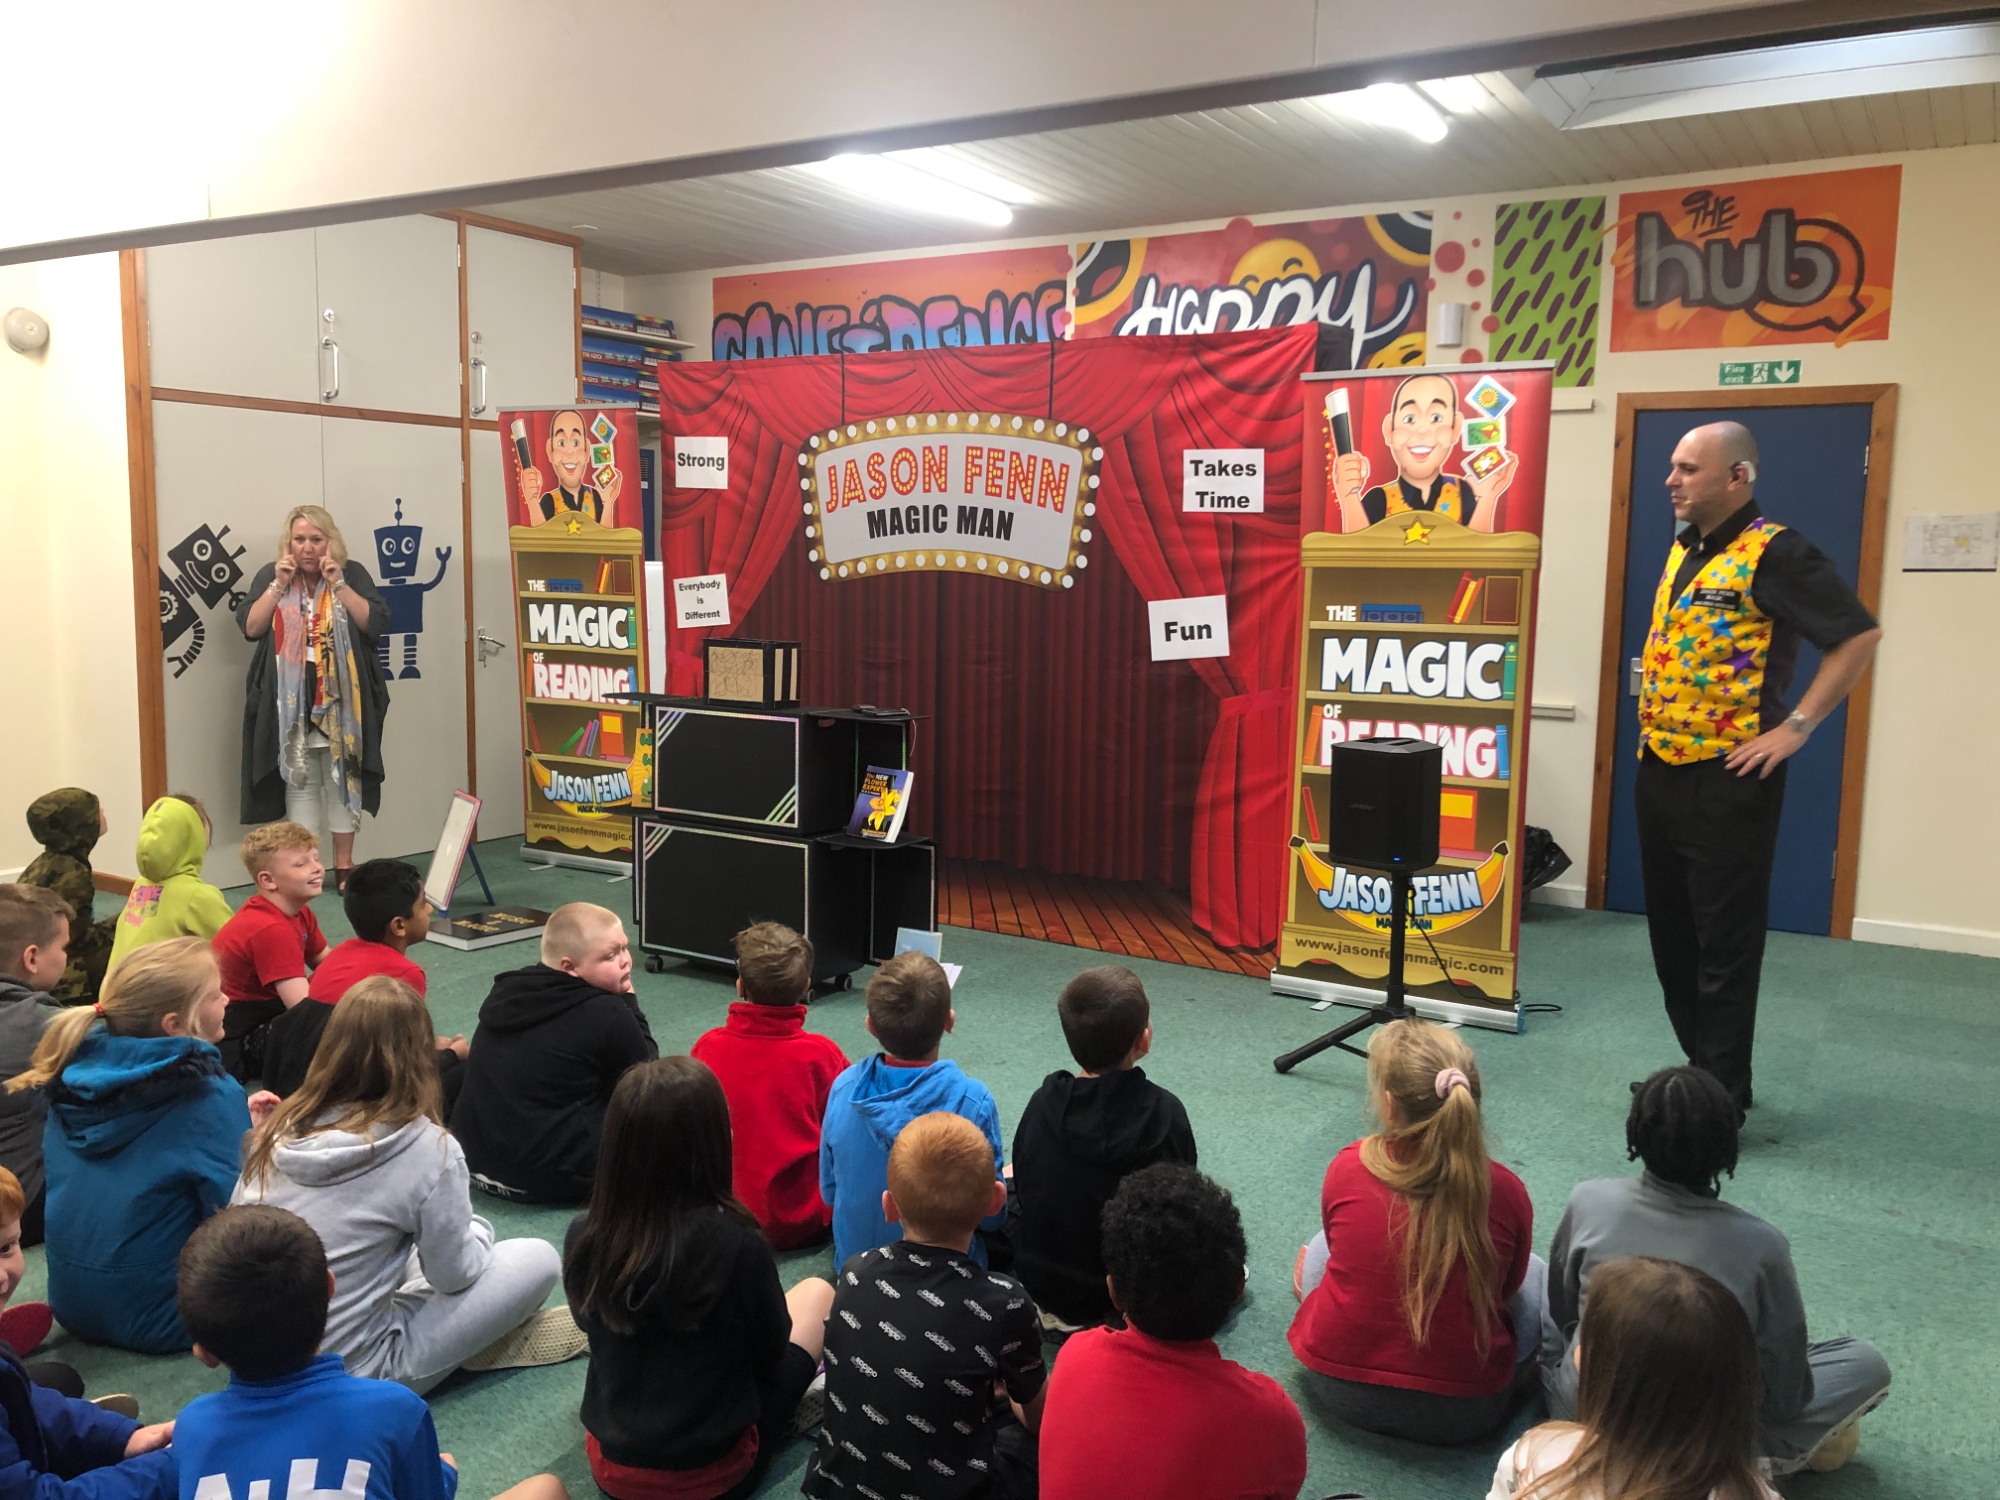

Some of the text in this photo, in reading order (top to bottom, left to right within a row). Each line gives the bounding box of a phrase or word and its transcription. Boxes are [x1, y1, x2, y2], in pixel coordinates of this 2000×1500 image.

[1681, 190, 1739, 231] THE
[1635, 209, 1839, 308] hub
[1725, 365, 1746, 373] Fire
[1725, 375, 1745, 383] exit
[677, 452, 725, 471] Strong
[1189, 459, 1257, 477] Takes
[825, 445, 1071, 514] JASON FENN
[1195, 491, 1250, 509] Time
[867, 504, 1015, 541] MAGIC MAN
[527, 579, 545, 592] THE
[678, 579, 721, 592] Everybody
[696, 597, 704, 605] is
[684, 610, 721, 620] Different
[1326, 605, 1357, 622] THE
[528, 603, 629, 650] MAGIC
[1164, 621, 1212, 642] Fun
[533, 652, 544, 663] OF
[1321, 637, 1505, 700] MAGIC
[533, 664, 630, 705] READING
[1323, 704, 1342, 718] OF
[543, 770, 633, 803] JASON FENN
[533, 821, 632, 841] www.jasonfennmagic.c
[1318, 866, 1484, 916] JASO FENN
[1295, 937, 1505, 976] www.jasonfenmagic.com
